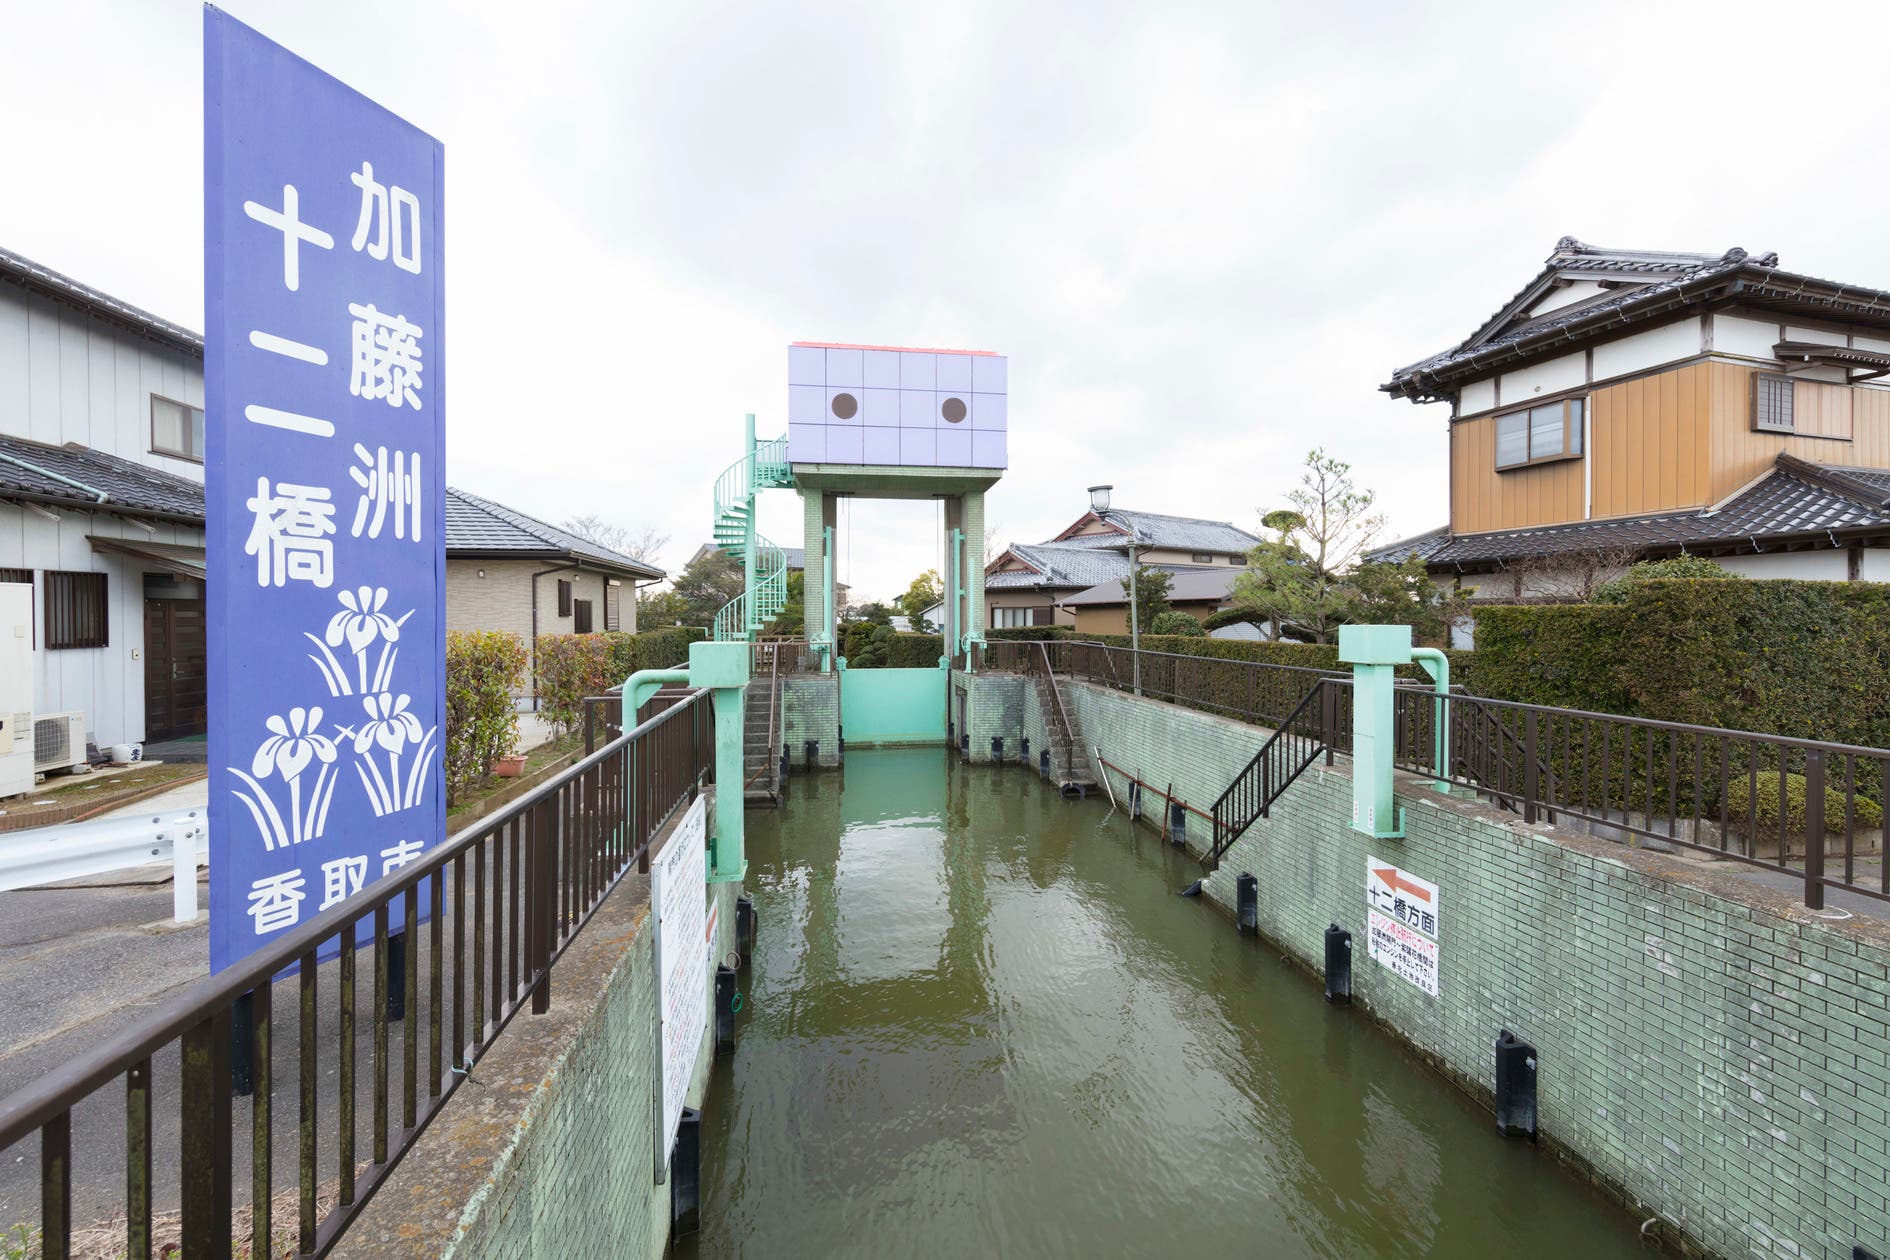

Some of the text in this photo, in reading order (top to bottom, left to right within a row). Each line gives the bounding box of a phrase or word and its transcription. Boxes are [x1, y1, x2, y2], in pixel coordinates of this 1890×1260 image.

[243, 183, 337, 589] 十二橋
[347, 160, 425, 543] 加藤洲
[1369, 885, 1436, 936] 十二橋方面
